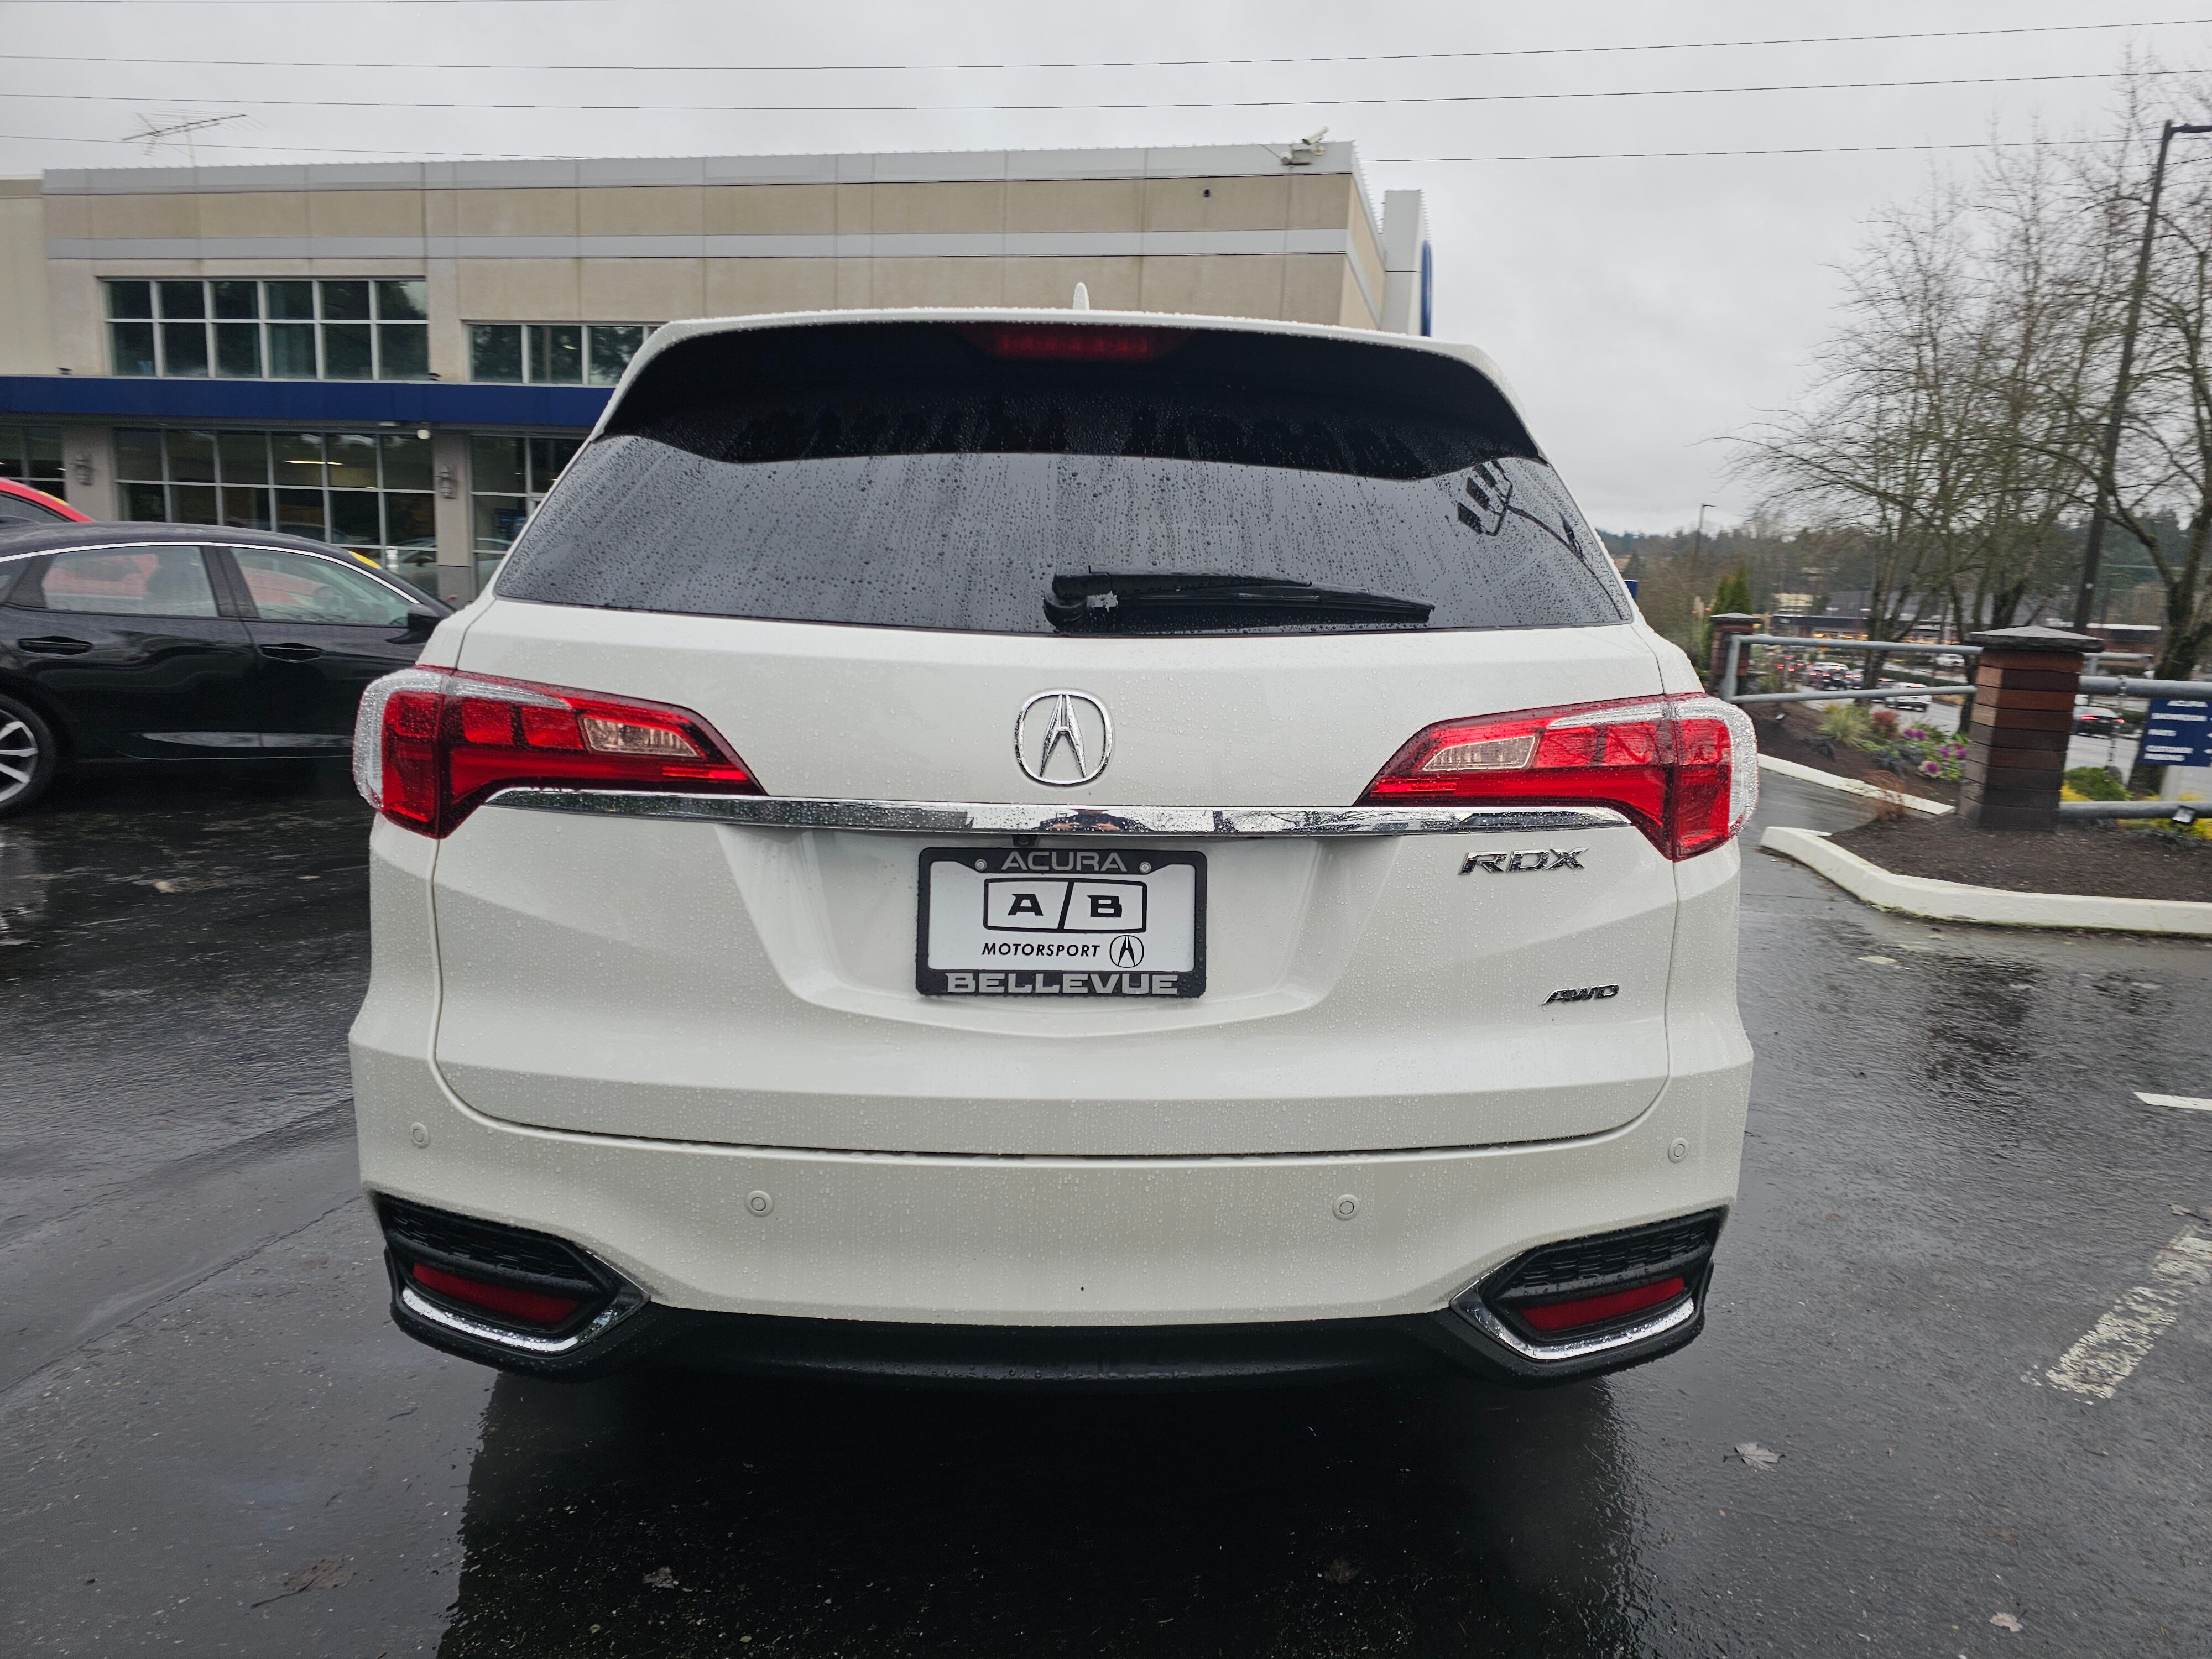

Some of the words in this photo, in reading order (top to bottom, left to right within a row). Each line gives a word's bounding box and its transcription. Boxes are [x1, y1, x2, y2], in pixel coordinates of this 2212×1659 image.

[1001, 851, 1128, 872] ACURA
[1458, 847, 1589, 875] RDX
[982, 943, 1100, 957] MOTORSPORT
[945, 973, 1178, 994] BELLEVUE
[1541, 984, 1620, 1006] AWD
